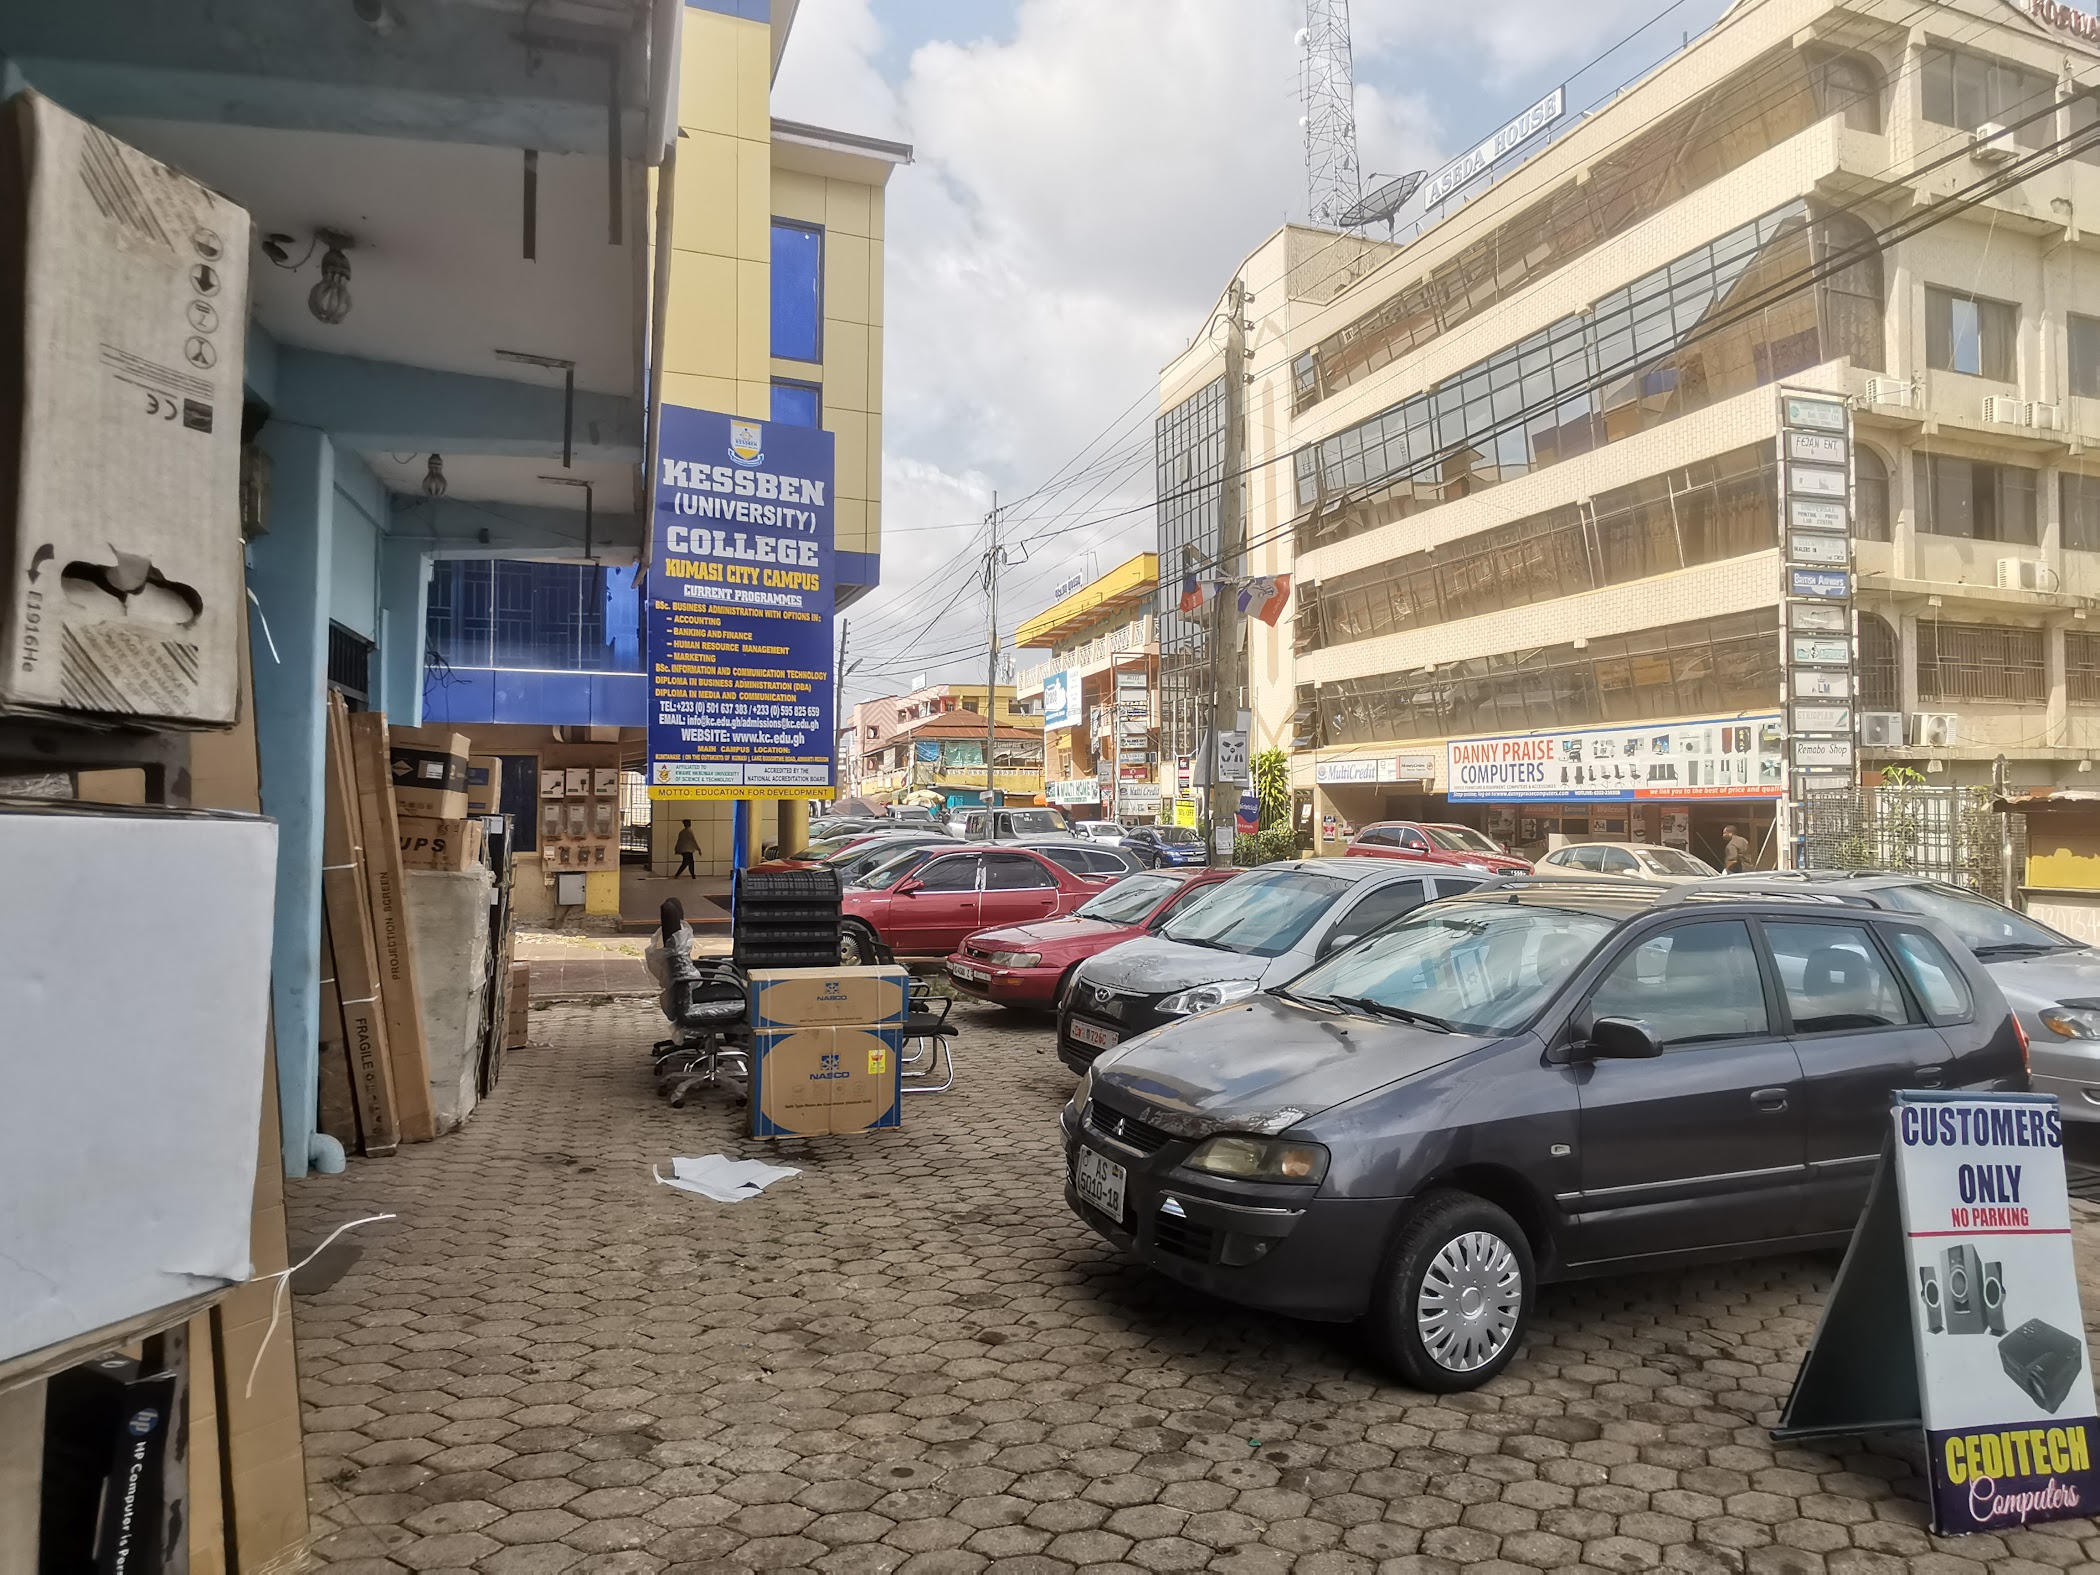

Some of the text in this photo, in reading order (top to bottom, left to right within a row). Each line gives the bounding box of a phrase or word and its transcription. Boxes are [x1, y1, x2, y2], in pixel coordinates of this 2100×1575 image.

[1429, 94, 1557, 204] ASEDA HOUSE
[662, 458, 824, 506] KESSBEN
[674, 492, 816, 533] (UNIVERSITY)
[667, 526, 819, 567] COLLEGE
[666, 558, 820, 591] KUMASI CITY CAMPUS
[684, 584, 803, 606] CURRENT PROGRAMMES
[672, 602, 706, 613] BUSINESS
[708, 604, 764, 618] ADMINISTRATION
[765, 609, 781, 619] WITH
[783, 611, 811, 621] OPTIONS
[674, 615, 721, 626] ACCOUNTING
[673, 627, 753, 640] BANKING AND FINANCE
[673, 640, 790, 655] HUMAN RESOURCE MANAGEMENT
[673, 652, 716, 662] MARKETING
[672, 664, 716, 674] INFORMATION
[717, 666, 731, 675] AND
[732, 668, 785, 678] COMMUNICATION
[786, 670, 827, 680] TECHNOLOGY
[655, 676, 812, 692] DIPLOMA IN BUSINESS ADMINISTRATION (DBA)
[655, 688, 688, 697] DIPLOMA
[699, 690, 720, 699] MEDIA
[739, 693, 797, 702] COMMUNICATION
[659, 714, 686, 725] EMAIL:
[695, 702, 705, 715] (0)
[706, 703, 719, 714] 501
[721, 704, 734, 714] 637
[753, 705, 769, 715] +233
[770, 705, 780, 718] (0)
[780, 706, 793, 716] 595
[794, 706, 807, 716] 825
[807, 706, 820, 717] 659
[681, 728, 805, 747] WEBSITE: www.kc.edu.gh
[1453, 740, 1554, 764] DANNY PRAISE
[1829, 744, 1848, 757] Shop
[1461, 762, 1544, 784] COMPUTERS
[1728, 786, 1745, 795] price
[400, 837, 446, 852] UPS
[380, 871, 400, 980] PROJECTION SCREEN
[355, 1018, 374, 1070] FRAGILE
[810, 1072, 850, 1080] NASCO
[1901, 1106, 2062, 1148] CUSTOMERS
[1096, 1158, 1108, 1182] AS
[1081, 1172, 1119, 1212] 5010-18
[1958, 1164, 2022, 1204] ONLY
[1951, 1207, 2029, 1227] NO PARKING
[130, 1410, 158, 1432] hp
[1945, 1426, 2090, 1485] CEDITECH
[120, 1462, 143, 1532] Computer
[1969, 1476, 2081, 1523] Computers
